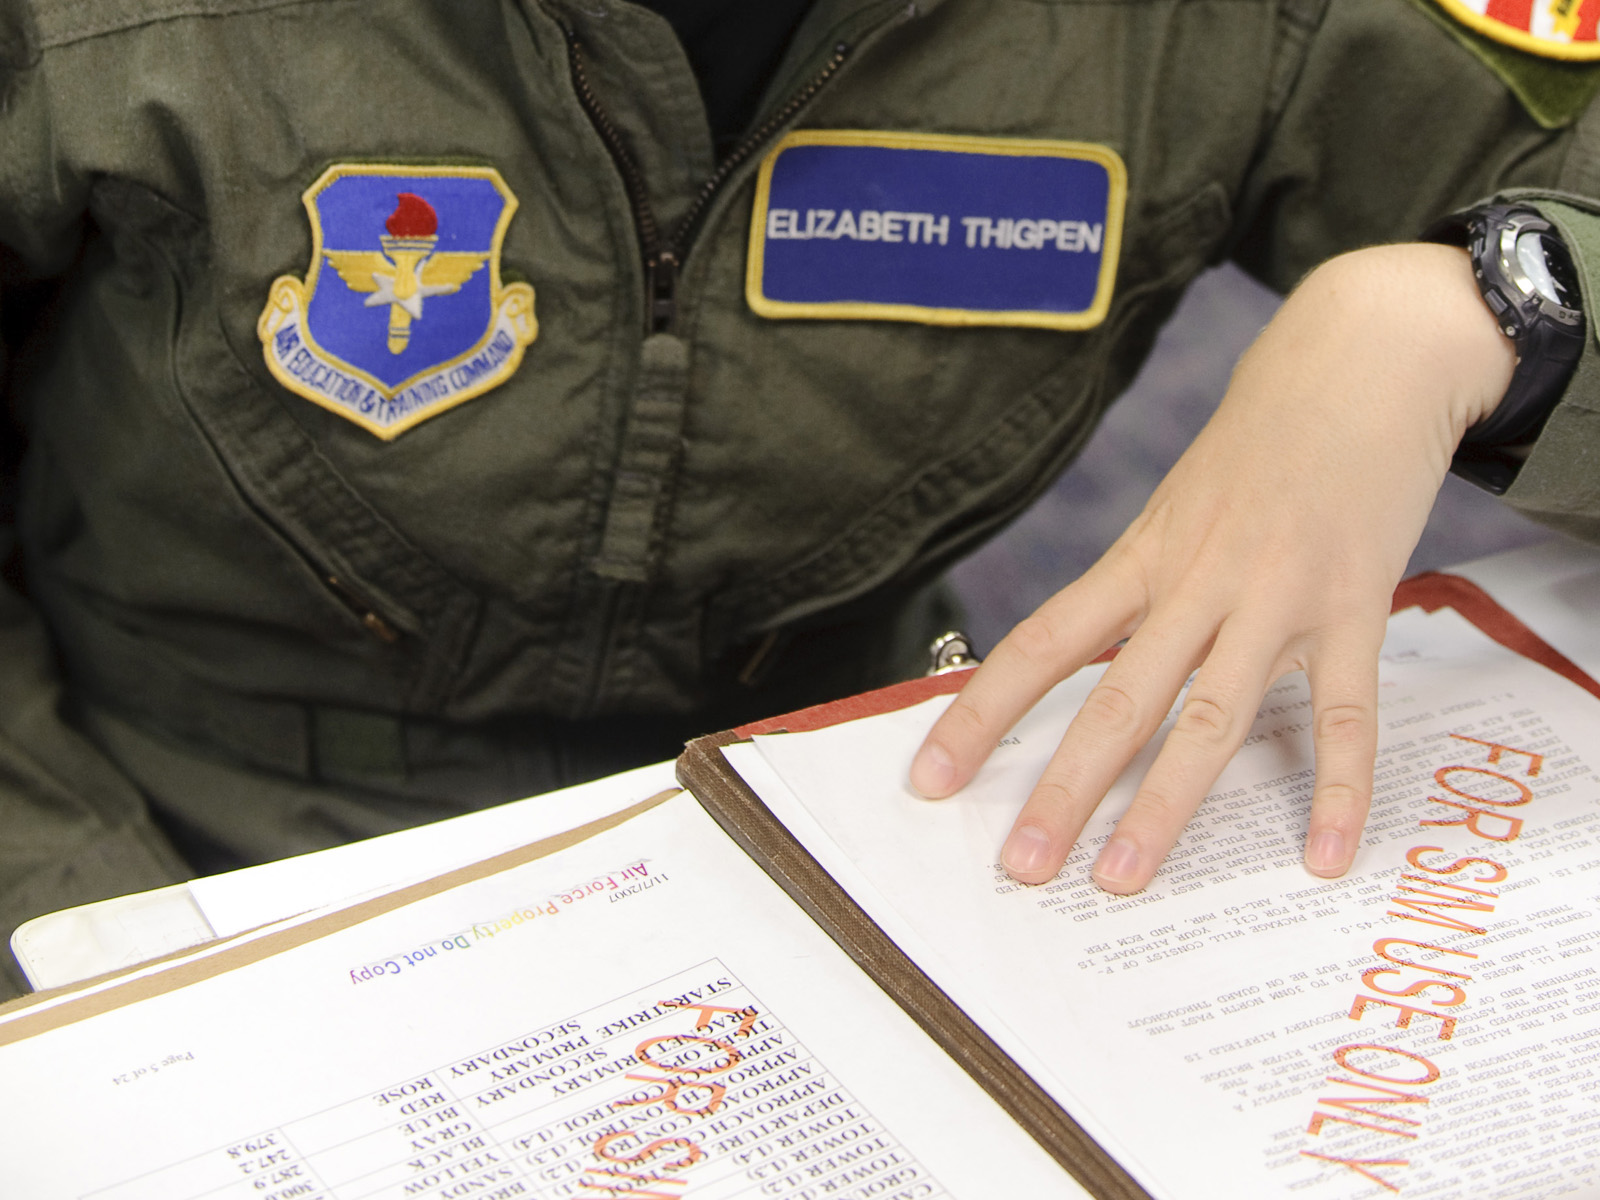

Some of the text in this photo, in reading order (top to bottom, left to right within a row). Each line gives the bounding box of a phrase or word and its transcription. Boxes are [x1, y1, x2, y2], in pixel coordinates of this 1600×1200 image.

[766, 208, 1102, 253] ELIZABETH THIGPEN
[275, 323, 300, 361] AIR
[449, 329, 515, 391] COMMAND
[287, 348, 365, 400] EDUCATION
[377, 375, 448, 422] TRAINING
[1252, 769, 1316, 791] INCLUDES
[1208, 794, 1313, 825] THE FACT THAT
[1222, 792, 1272, 811] FITTED
[1186, 831, 1214, 842] THE
[1212, 822, 1301, 847] OF THE FULL
[1364, 837, 1382, 845] IN
[1037, 836, 1286, 908] ANTICIPATED THE
[1162, 866, 1219, 885] THREAT.
[1209, 873, 1237, 884] THE
[1241, 864, 1268, 875] ARE
[606, 873, 669, 903] 11/7/2007
[1168, 882, 1204, 895] BEST
[1278, 874, 1365, 903] DISPENSERS,
[1356, 884, 1383, 895] AND
[1054, 899, 1098, 915] SMALL
[1104, 893, 1164, 913] TRAINED
[1223, 898, 1273, 916] ARL-69
[1264, 906, 1290, 917] FOR
[1295, 891, 1351, 911] E-3/E-8
[1072, 910, 1100, 922] AND
[1312, 907, 1339, 918] THE
[1523, 903, 1573, 921] THREAT
[1535, 910, 1592, 929] CENTRAL
[344, 863, 652, 989] Air Force Property Do not Copy
[1148, 925, 1177, 937] AND
[1174, 927, 1211, 941] YOUR
[1249, 913, 1306, 934] PACKAGE
[1116, 934, 1143, 945] ECM
[1208, 929, 1246, 944] WILL
[1450, 926, 1532, 953] WASHINGTON
[1083, 943, 1111, 954] PER
[1100, 939, 1171, 962] AIRCRAFT
[1142, 941, 1205, 962] CONSIST
[1391, 947, 1409, 956] IS
[1419, 949, 1446, 960] AND
[1076, 960, 1096, 969] IS
[1119, 960, 1139, 969] OF
[1299, 733, 1543, 1193] FOR SIM USE ONLY
[1313, 964, 1340, 975] BUT
[1264, 979, 1285, 988] ON
[1289, 972, 1309, 982] BE
[1309, 979, 1328, 988] TO
[1334, 973, 1352, 982] 20
[1214, 986, 1261, 1003] GUARD
[1268, 985, 1305, 1000] 30NM
[1124, 1000, 1212, 1029] THROUGHOUT
[1219, 997, 1265, 1014] NORTH
[650, 1005, 760, 1054] DRAGNET
[1145, 1024, 1174, 1035] THE
[1177, 1012, 1214, 1026] PAST
[159, 1049, 195, 1069] Page
[613, 1000, 758, 1116] FOR
[110, 1074, 131, 1086] 24
[128, 1067, 149, 1080] of
[238, 977, 733, 1175] STARSTRIKE PRIMARY RED 247.2
[546, 1049, 651, 1097] PRIMARY
[679, 1048, 803, 1103] APPROACH
[226, 1019, 581, 1160] SECONDARY ROSE 379.8
[407, 1019, 774, 1172] TIGER OPS BLACK
[693, 1063, 817, 1119] APPROACH
[400, 1034, 788, 1197] APPROACH CONTROL (L4) YELLOW
[707, 1078, 831, 1134] APPROACH
[250, 1047, 608, 1191] SECONDARY BLUE 287.9
[568, 1099, 679, 1149] CONTROL
[774, 1107, 861, 1148] TOWER
[406, 1121, 473, 1153] GRAY
[582, 1114, 694, 1164] CONTROL
[598, 1093, 846, 1200] DEPARTURE CONTROL
[788, 1122, 875, 1163] TOWER
[524, 1143, 569, 1167] (L3)
[596, 1129, 708, 1179] CONTROL
[803, 1137, 890, 1177] TOWER
[537, 1159, 583, 1182] (L2)
[818, 1152, 905, 1193] TOWER
[837, 1167, 920, 1200] GROU
